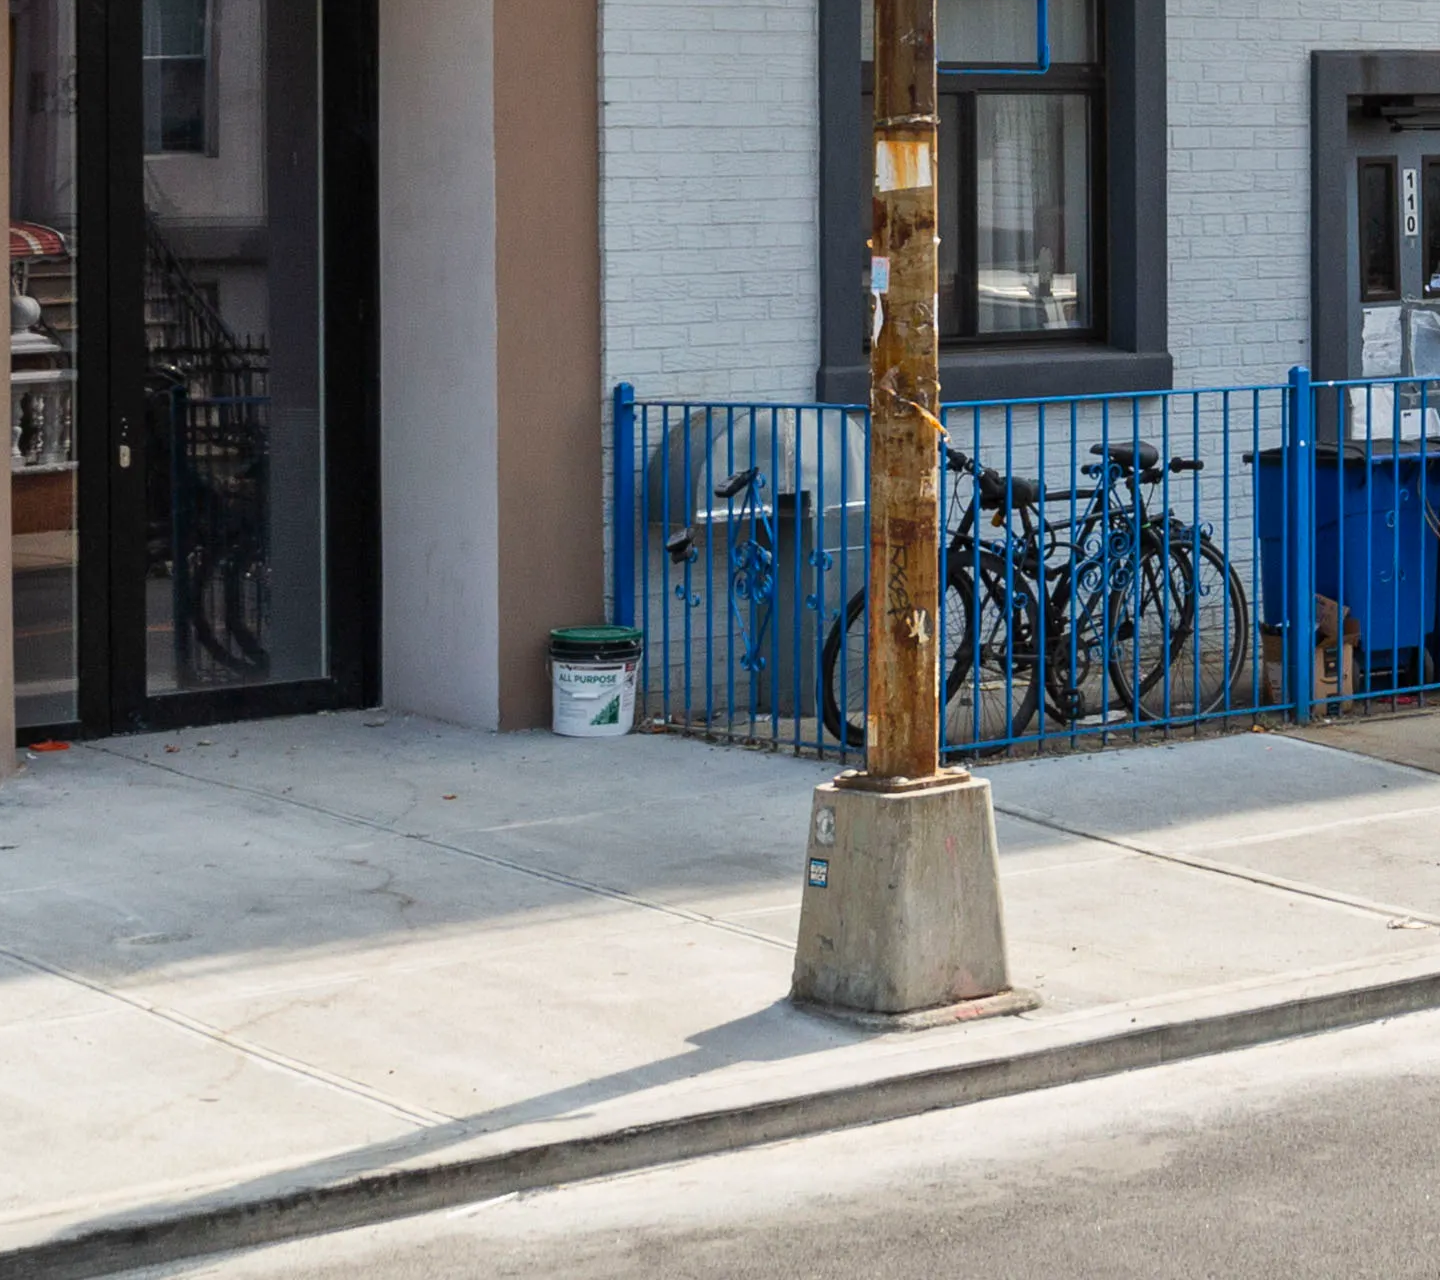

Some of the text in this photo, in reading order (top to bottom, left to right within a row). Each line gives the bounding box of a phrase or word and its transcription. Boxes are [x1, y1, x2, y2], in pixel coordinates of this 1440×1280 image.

[1405, 172, 1416, 233] 110
[559, 674, 617, 684] ALL PURPOSE
